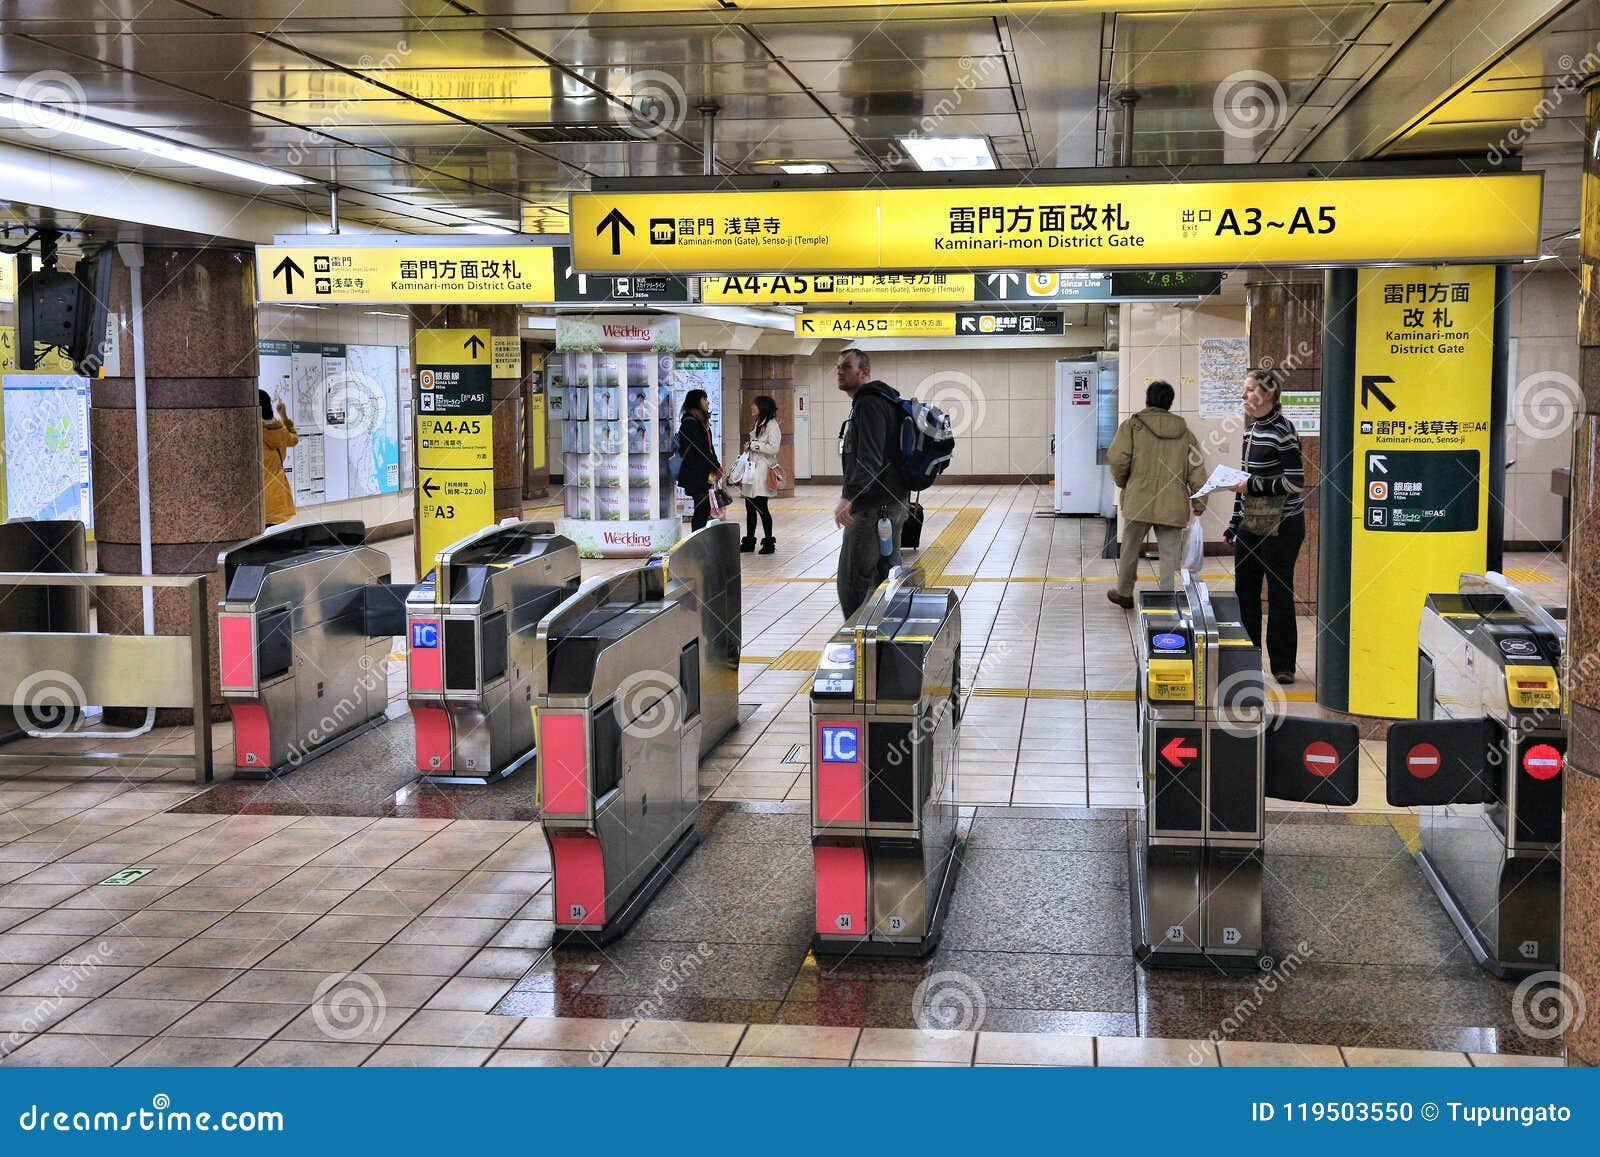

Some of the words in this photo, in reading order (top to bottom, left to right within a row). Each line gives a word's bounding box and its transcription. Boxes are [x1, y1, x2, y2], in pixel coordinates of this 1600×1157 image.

[950, 203, 1130, 234] 雷門方面改札
[1182, 209, 1211, 223] 出口
[678, 218, 714, 235] 雷門
[724, 217, 781, 235] 浅草寺
[678, 236, 732, 246] Kaminari-mon
[734, 236, 760, 246] (Gate),
[762, 235, 793, 247] Senso-ji
[795, 235, 829, 246] (Temple)
[935, 236, 1043, 250] Kaminari-mon
[1049, 235, 1103, 248] District
[1108, 234, 1145, 247] Gate
[331, 256, 352, 267] 雷門
[400, 260, 522, 279] 雷門方面改札
[332, 278, 364, 288] 浅草寺
[391, 281, 464, 290] Kaminari-mon
[467, 281, 504, 290] District
[507, 281, 532, 290] Gate
[1060, 280, 1081, 288] Ginza
[1084, 280, 1101, 288] Line
[1384, 283, 1470, 304] 雷門方面
[1403, 308, 1453, 328] 改札
[602, 324, 651, 341] Wedding
[1385, 330, 1470, 341] Kaminari-mon
[1390, 344, 1435, 354] District
[1438, 344, 1465, 354] Gate
[1376, 436, 1434, 444] Kaminari-mon,
[1436, 436, 1466, 445] Senso-ji
[435, 505, 455, 518] A3
[603, 531, 651, 547] Wedding
[413, 624, 438, 647] IC
[822, 730, 857, 760] IC
[573, 906, 582, 918] 24
[840, 916, 849, 928] 24
[891, 918, 900, 930] 23
[1172, 928, 1181, 939] 23
[1226, 930, 1236, 941] 22
[1525, 943, 1536, 955] 22
